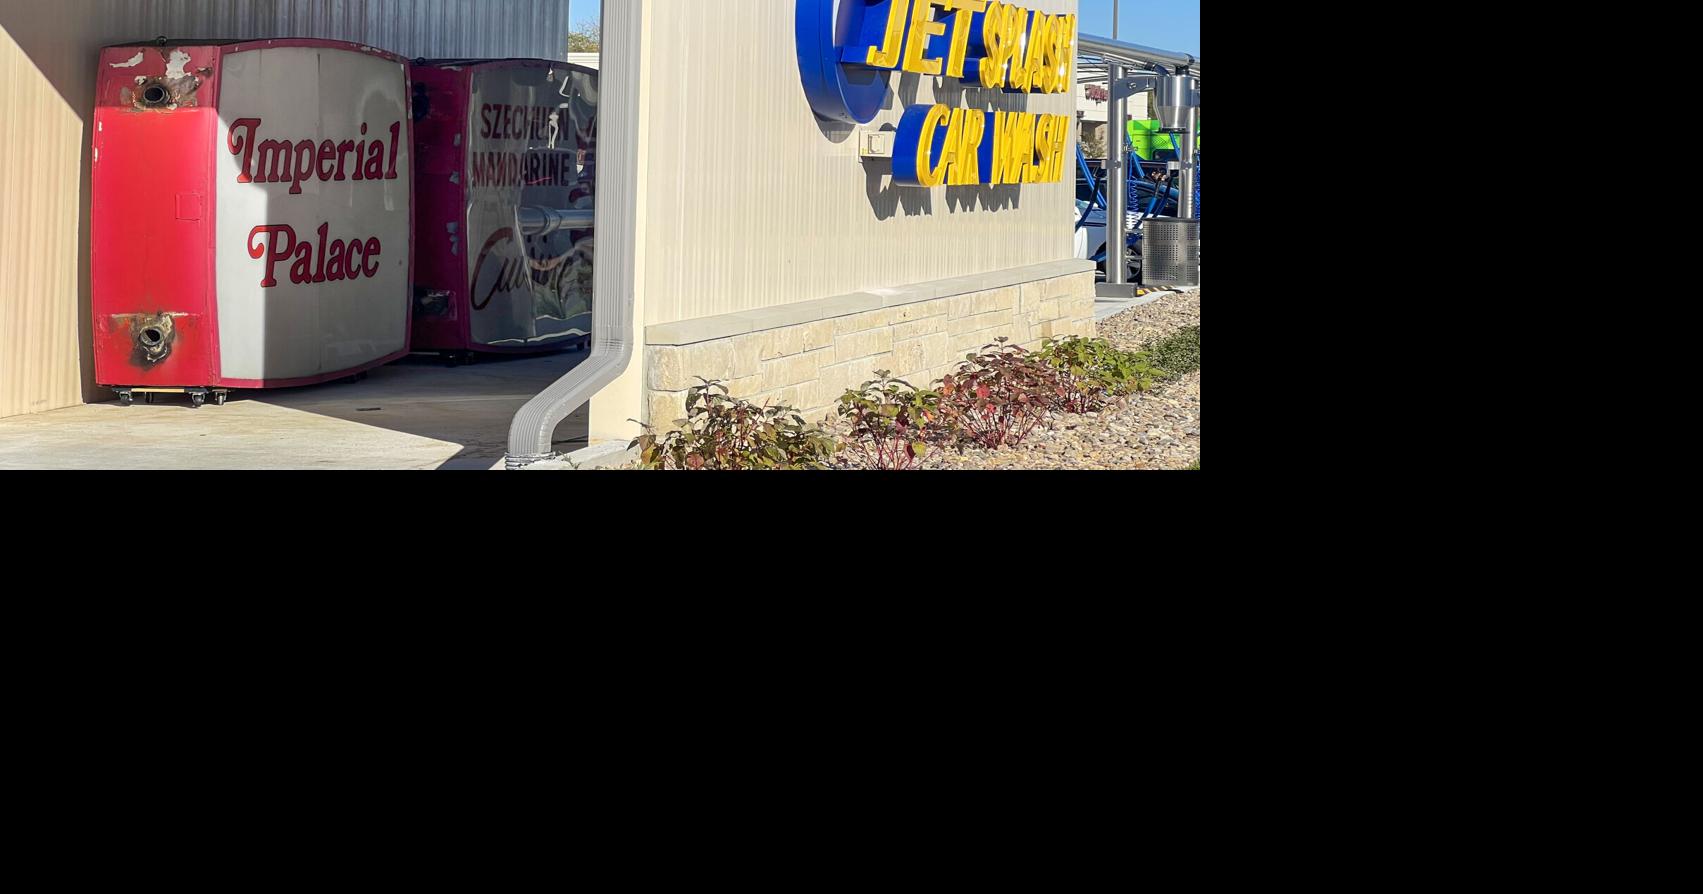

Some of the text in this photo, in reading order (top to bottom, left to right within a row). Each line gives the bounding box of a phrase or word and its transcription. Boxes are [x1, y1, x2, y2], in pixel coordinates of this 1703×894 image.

[866, 0, 1076, 94] JET SPLASH
[227, 117, 400, 194] Imperial
[916, 103, 1071, 188] CAR WASH
[247, 221, 381, 288] Palace
